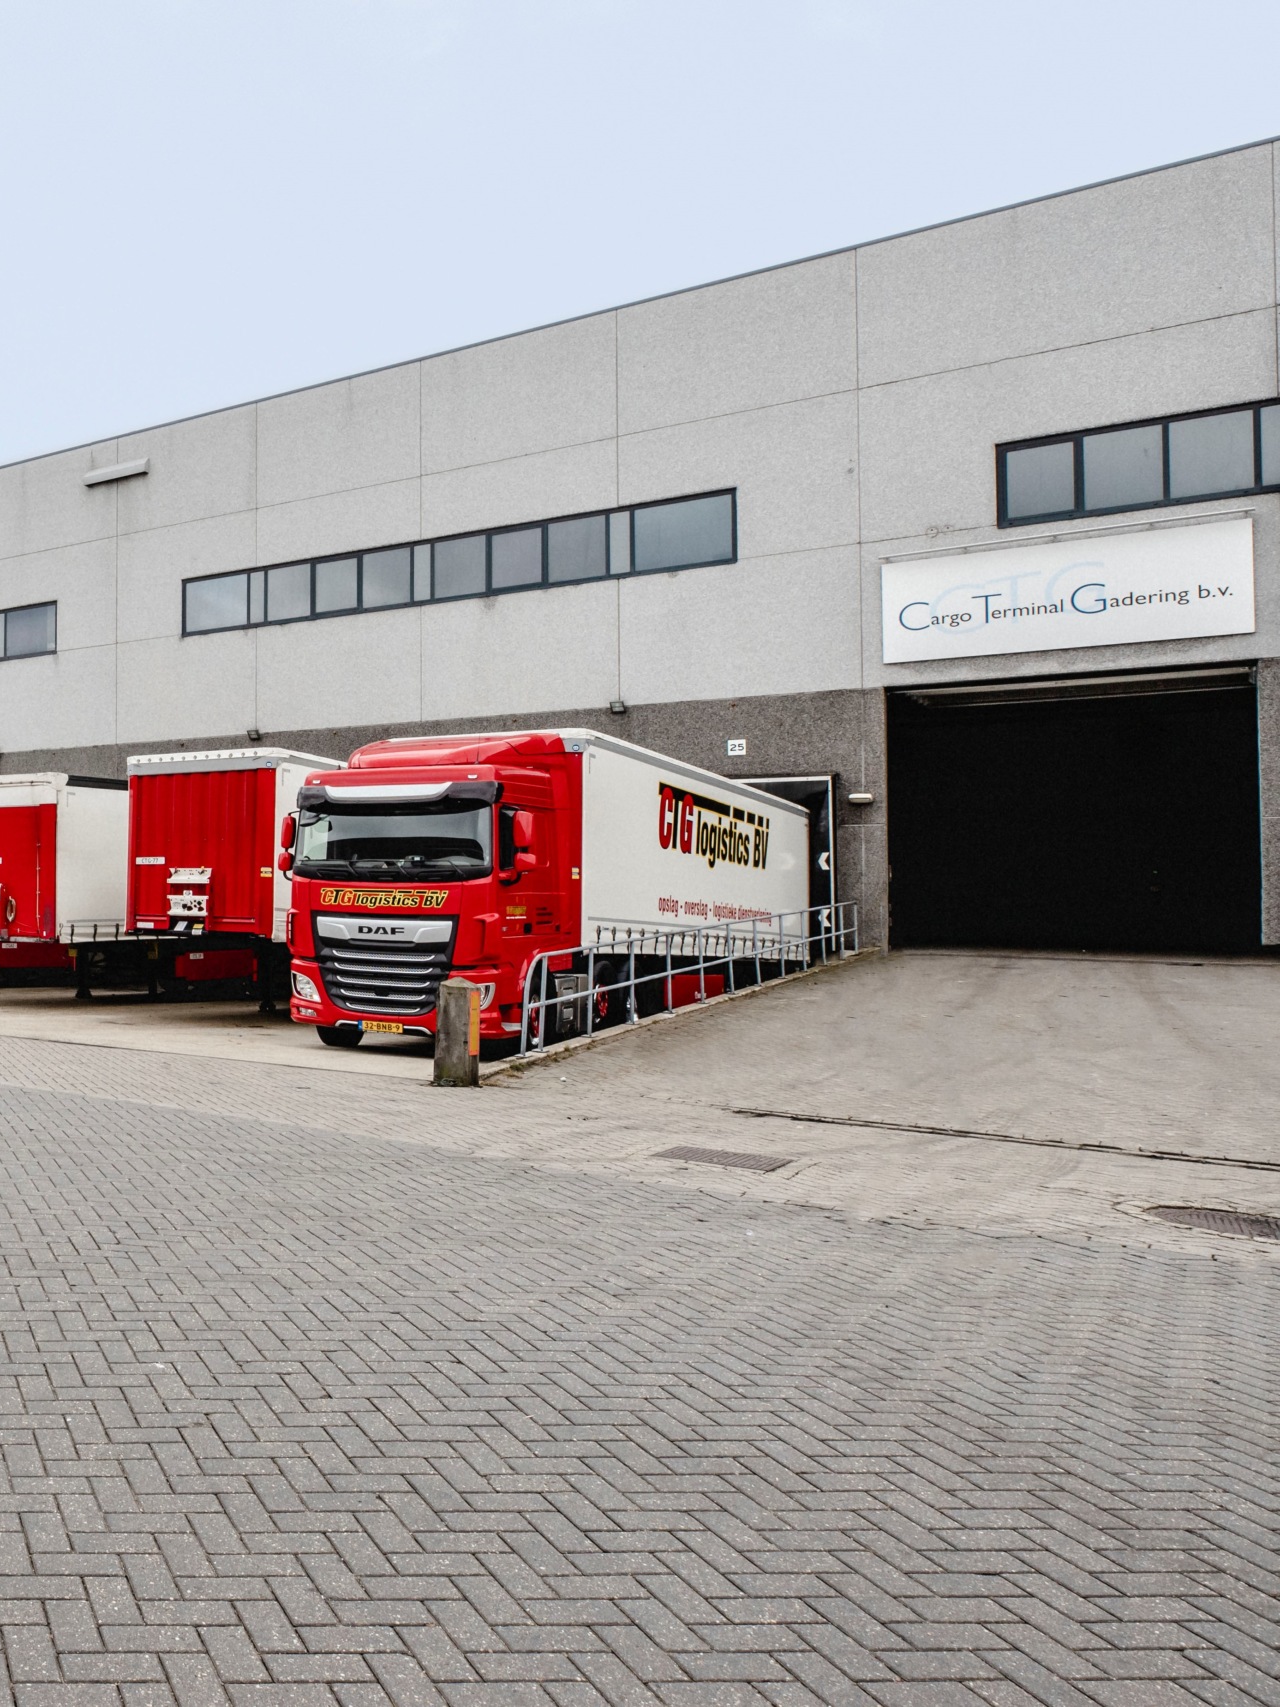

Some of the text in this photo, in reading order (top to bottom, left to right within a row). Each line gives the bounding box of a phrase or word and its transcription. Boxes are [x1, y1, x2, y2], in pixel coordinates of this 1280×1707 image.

[899, 583, 1234, 631] Cargo Terminal Gadering b.v.
[730, 743, 745, 752] 25
[695, 810, 750, 869] logistics
[753, 826, 770, 870] BV
[354, 891, 419, 908] logistics
[421, 890, 448, 908] BV
[658, 895, 679, 918] opslag
[684, 899, 708, 921] overslag
[713, 901, 737, 922] logistieke
[357, 925, 405, 935] DAF
[364, 1021, 401, 1032] 32-BNB-9
